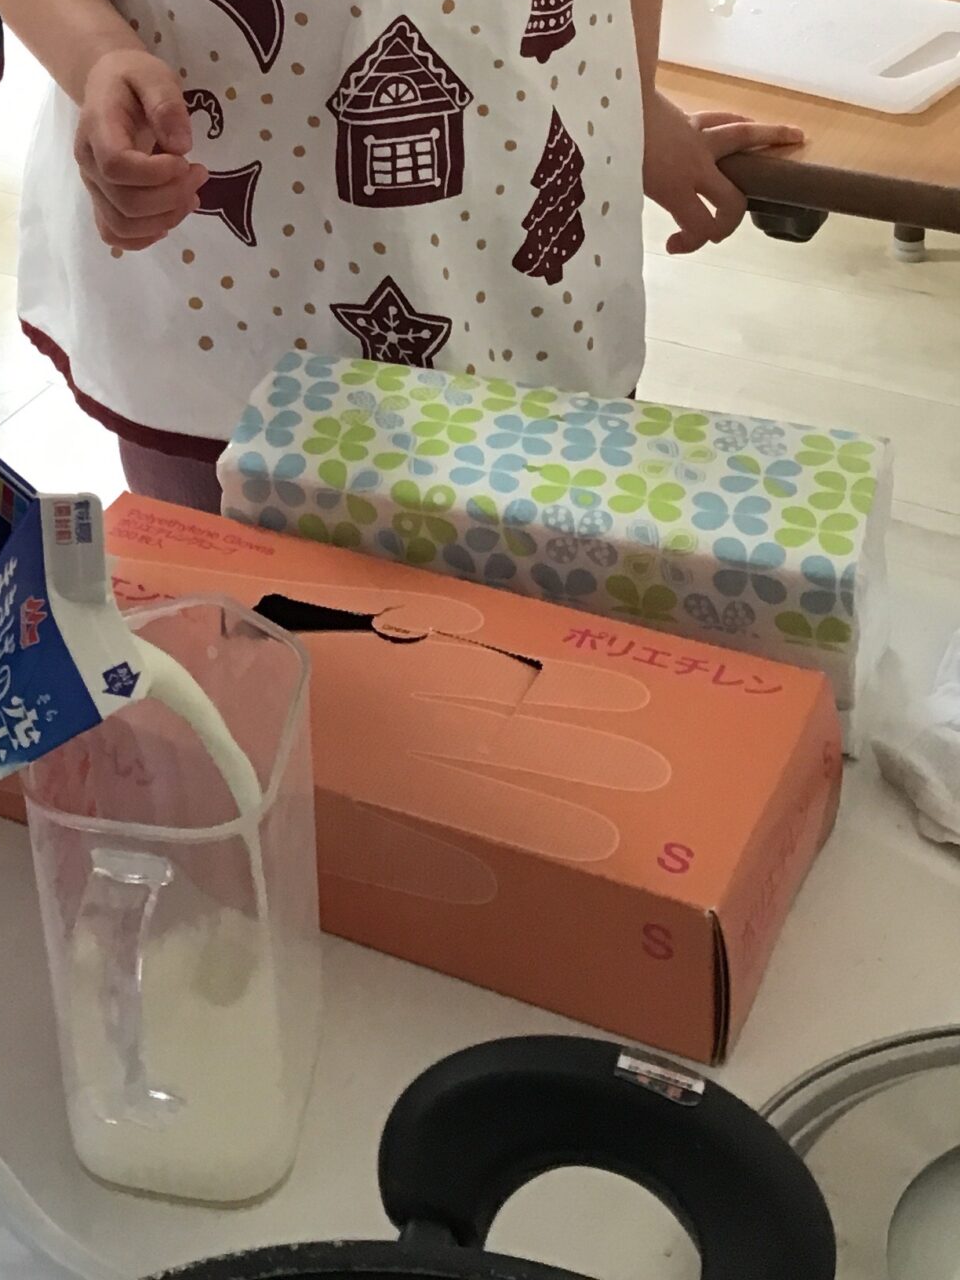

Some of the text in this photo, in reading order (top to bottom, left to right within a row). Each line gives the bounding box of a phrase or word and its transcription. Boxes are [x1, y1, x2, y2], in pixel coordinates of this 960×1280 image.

[562, 624, 783, 697] ポリエチレン
[656, 841, 695, 875] S
[641, 922, 675, 961] S
